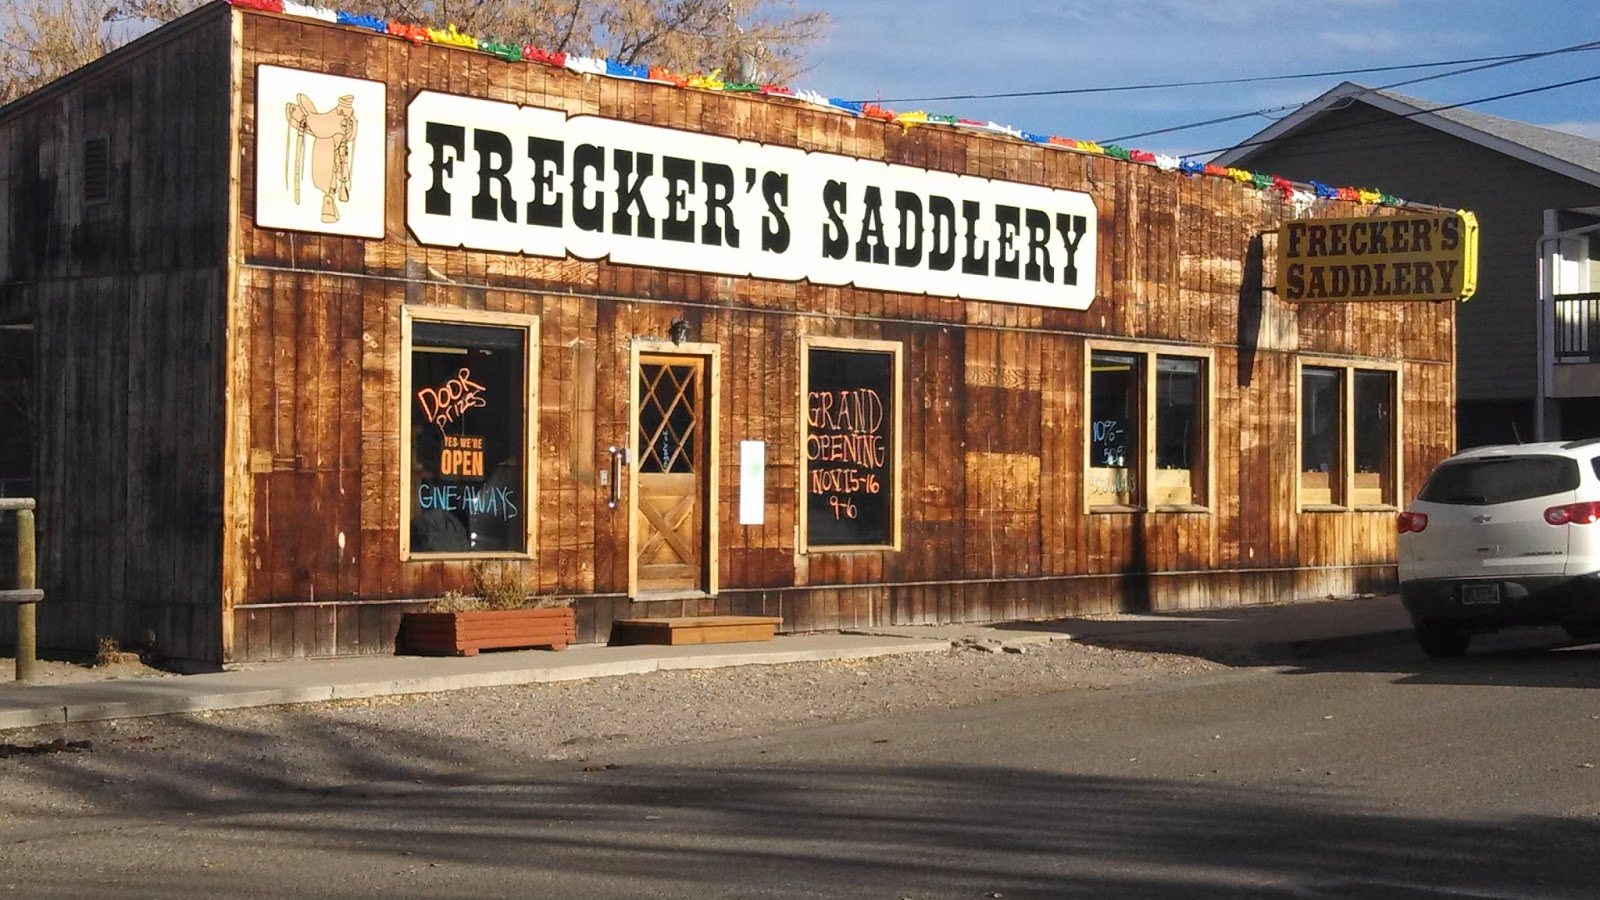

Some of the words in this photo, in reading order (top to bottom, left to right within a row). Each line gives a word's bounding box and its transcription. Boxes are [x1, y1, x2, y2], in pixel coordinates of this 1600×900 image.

[425, 121, 791, 254] FRECKER'S
[822, 179, 1087, 286] SADDLERY
[1286, 217, 1459, 258] FRECKER'S
[1286, 260, 1459, 299] SADDLERY
[418, 367, 486, 423] DOOR
[807, 388, 883, 434] GRAND
[441, 449, 484, 476] OPEN
[807, 433, 885, 469] OPENING
[812, 468, 842, 495] NOV
[829, 495, 858, 520] 9-6
